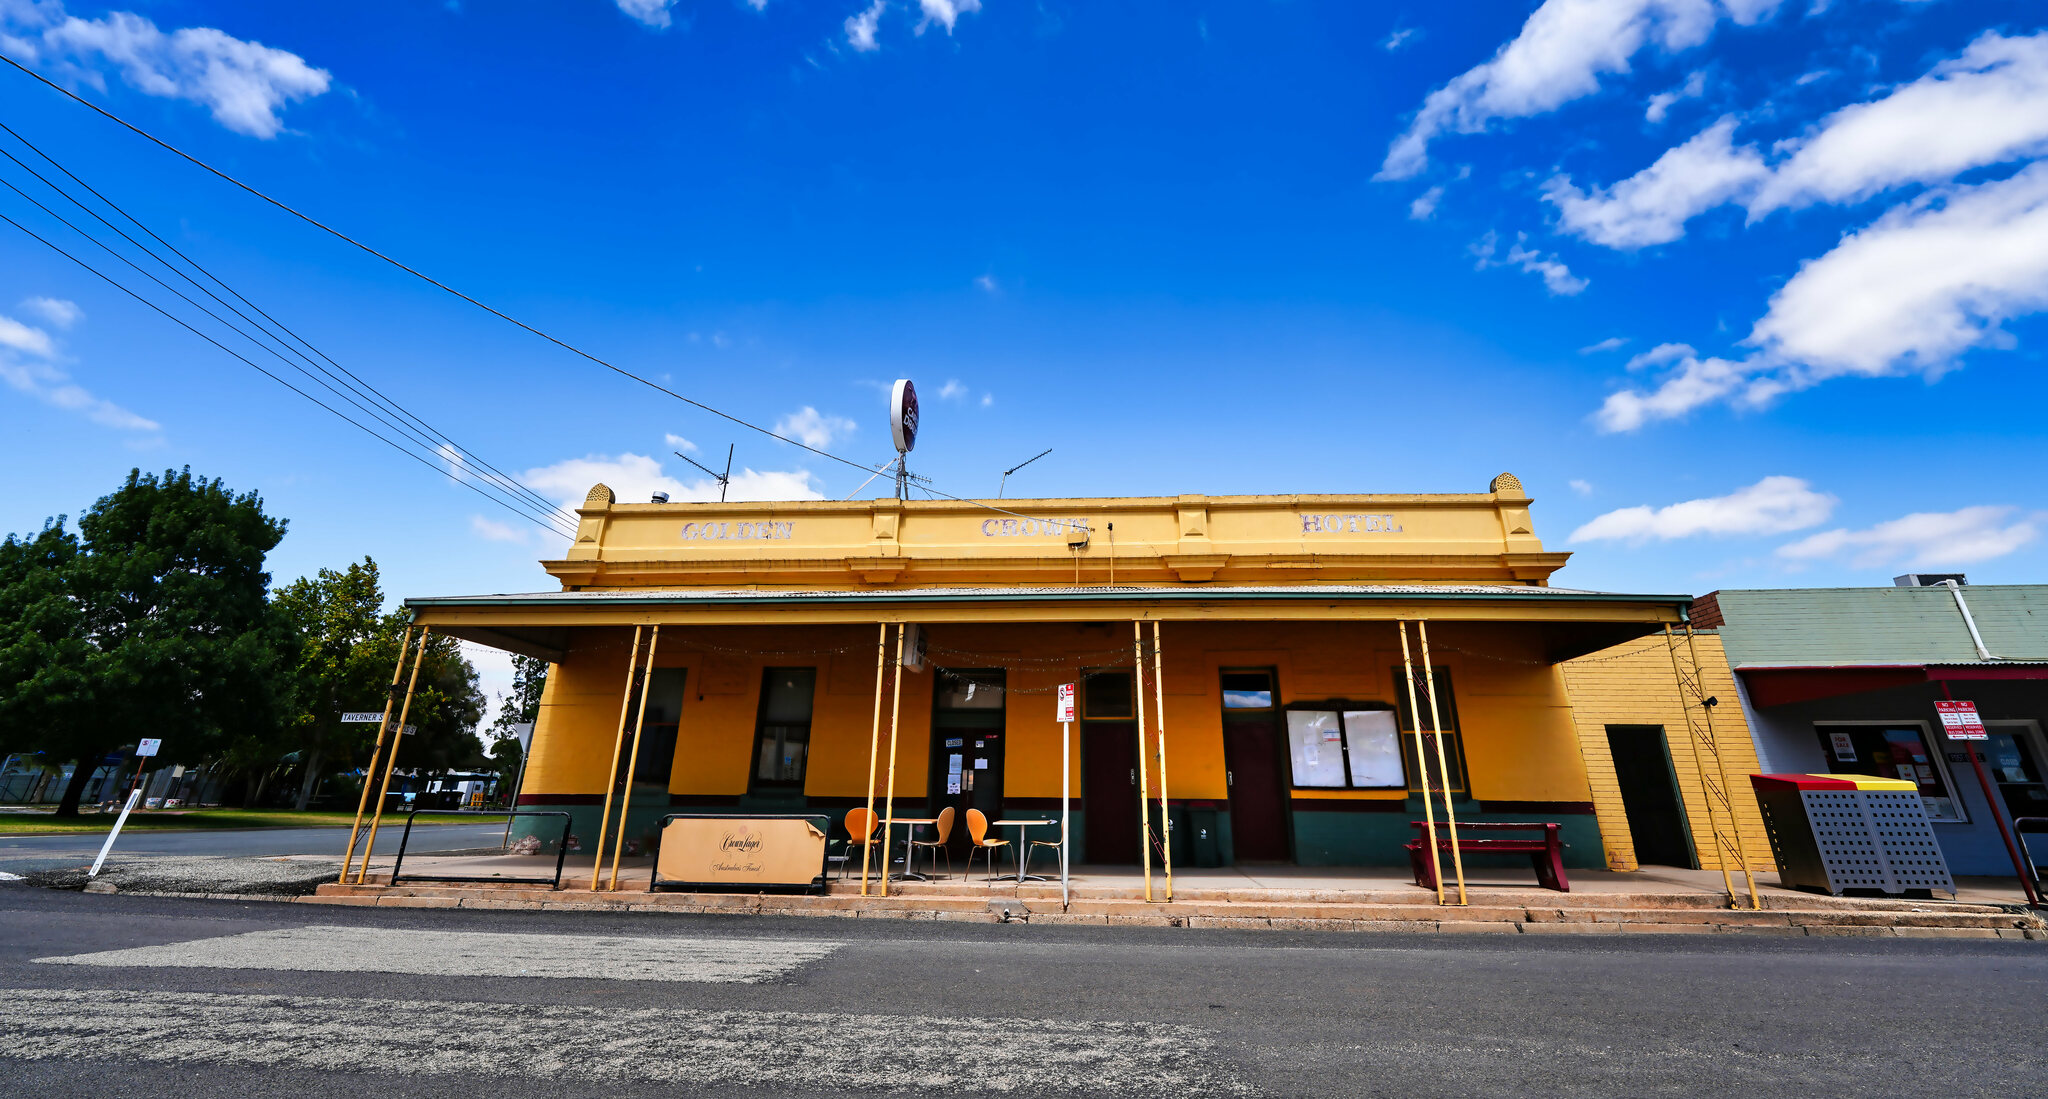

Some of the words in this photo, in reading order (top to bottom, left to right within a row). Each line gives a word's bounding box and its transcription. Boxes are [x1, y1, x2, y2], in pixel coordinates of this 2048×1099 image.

[681, 522, 795, 540] GOLDEN
[982, 518, 1088, 536] CROWN
[1300, 514, 1403, 533] HOTEL
[344, 713, 377, 721] TAVERNER
[722, 834, 744, 850] Crown
[738, 834, 760, 852] Lager
